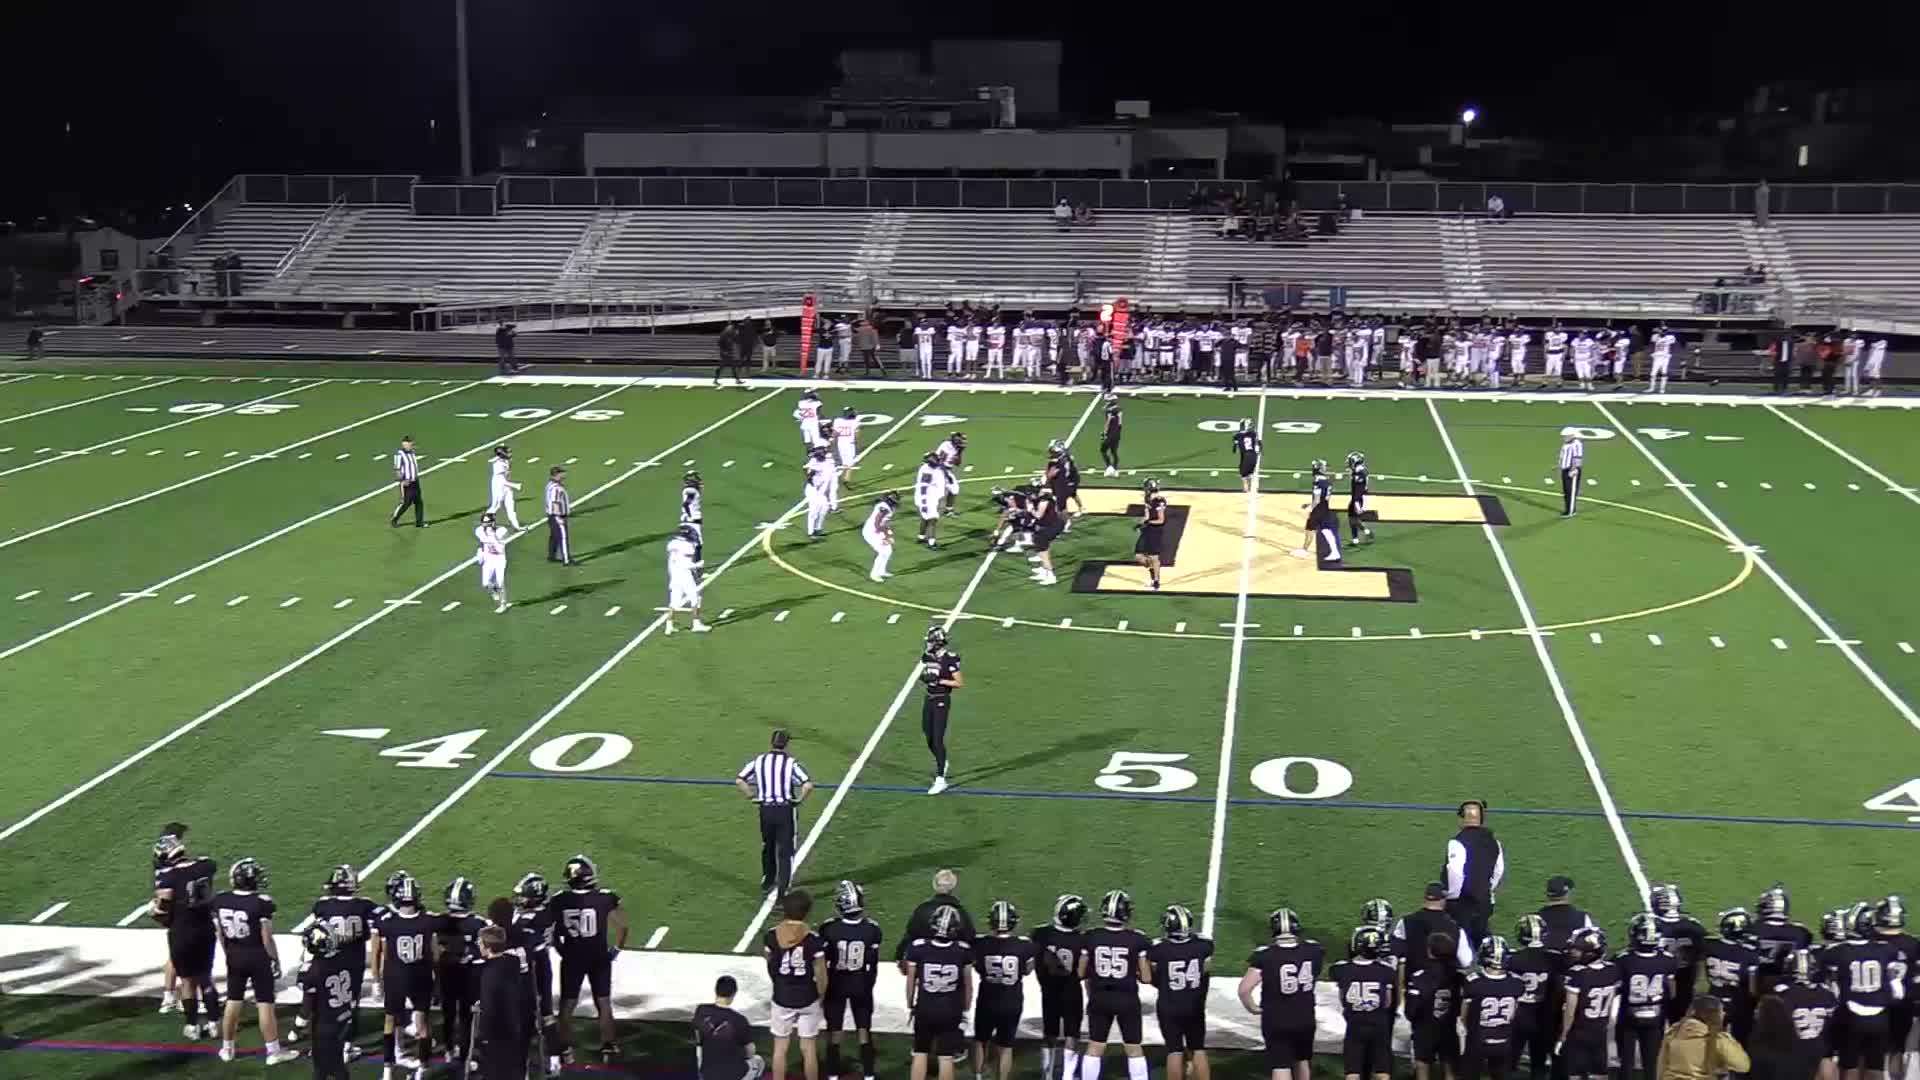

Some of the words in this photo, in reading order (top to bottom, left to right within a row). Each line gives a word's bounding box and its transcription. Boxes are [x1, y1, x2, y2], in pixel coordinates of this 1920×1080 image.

[1100, 304, 1113, 322] 2
[1243, 437, 1252, 450] 2
[218, 908, 250, 939] 56
[563, 908, 597, 938] 50
[836, 939, 865, 971] 18
[985, 955, 1019, 985] 59
[1094, 946, 1129, 979] 65
[325, 969, 353, 1008] 32
[923, 963, 958, 992] 52
[1168, 958, 1201, 991] 54
[1280, 961, 1314, 994] 64
[1849, 960, 1881, 993] 10
[1346, 981, 1380, 1012] 45
[1480, 997, 1515, 1027] 23
[1584, 985, 1616, 1018] 37
